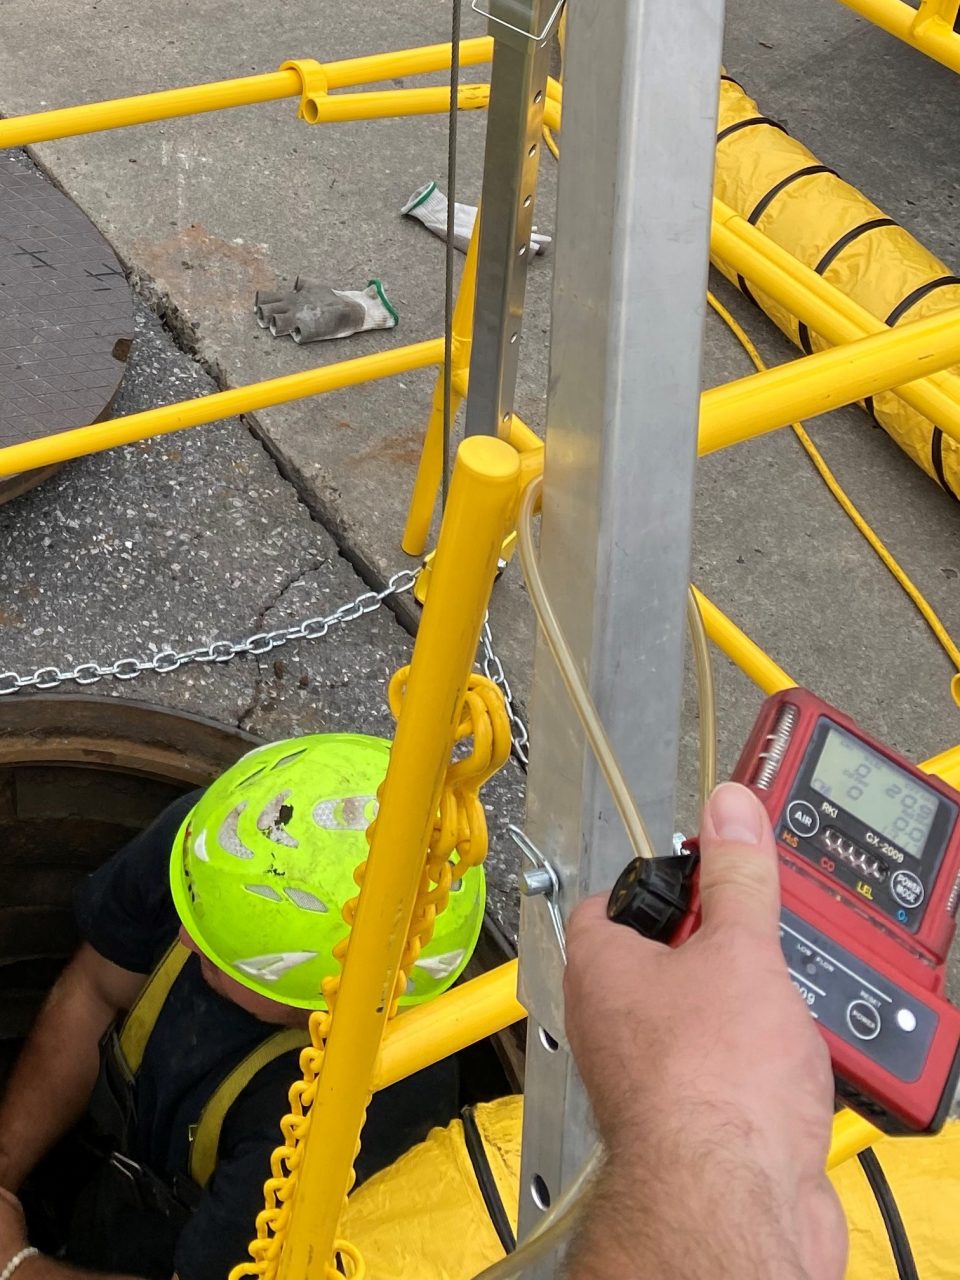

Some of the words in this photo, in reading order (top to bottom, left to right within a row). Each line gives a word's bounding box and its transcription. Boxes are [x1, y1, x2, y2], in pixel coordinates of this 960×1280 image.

[794, 810, 813, 827] AIR
[821, 802, 839, 818] RKI
[865, 832, 905, 863] GX-2009
[820, 856, 836, 872] CO
[856, 880, 874, 901] LEL
[895, 885, 916, 904] MODE
[896, 873, 922, 895] POWER
[797, 943, 813, 957] LOW
[816, 956, 835, 973] FLOW
[852, 1009, 876, 1030] POWER
